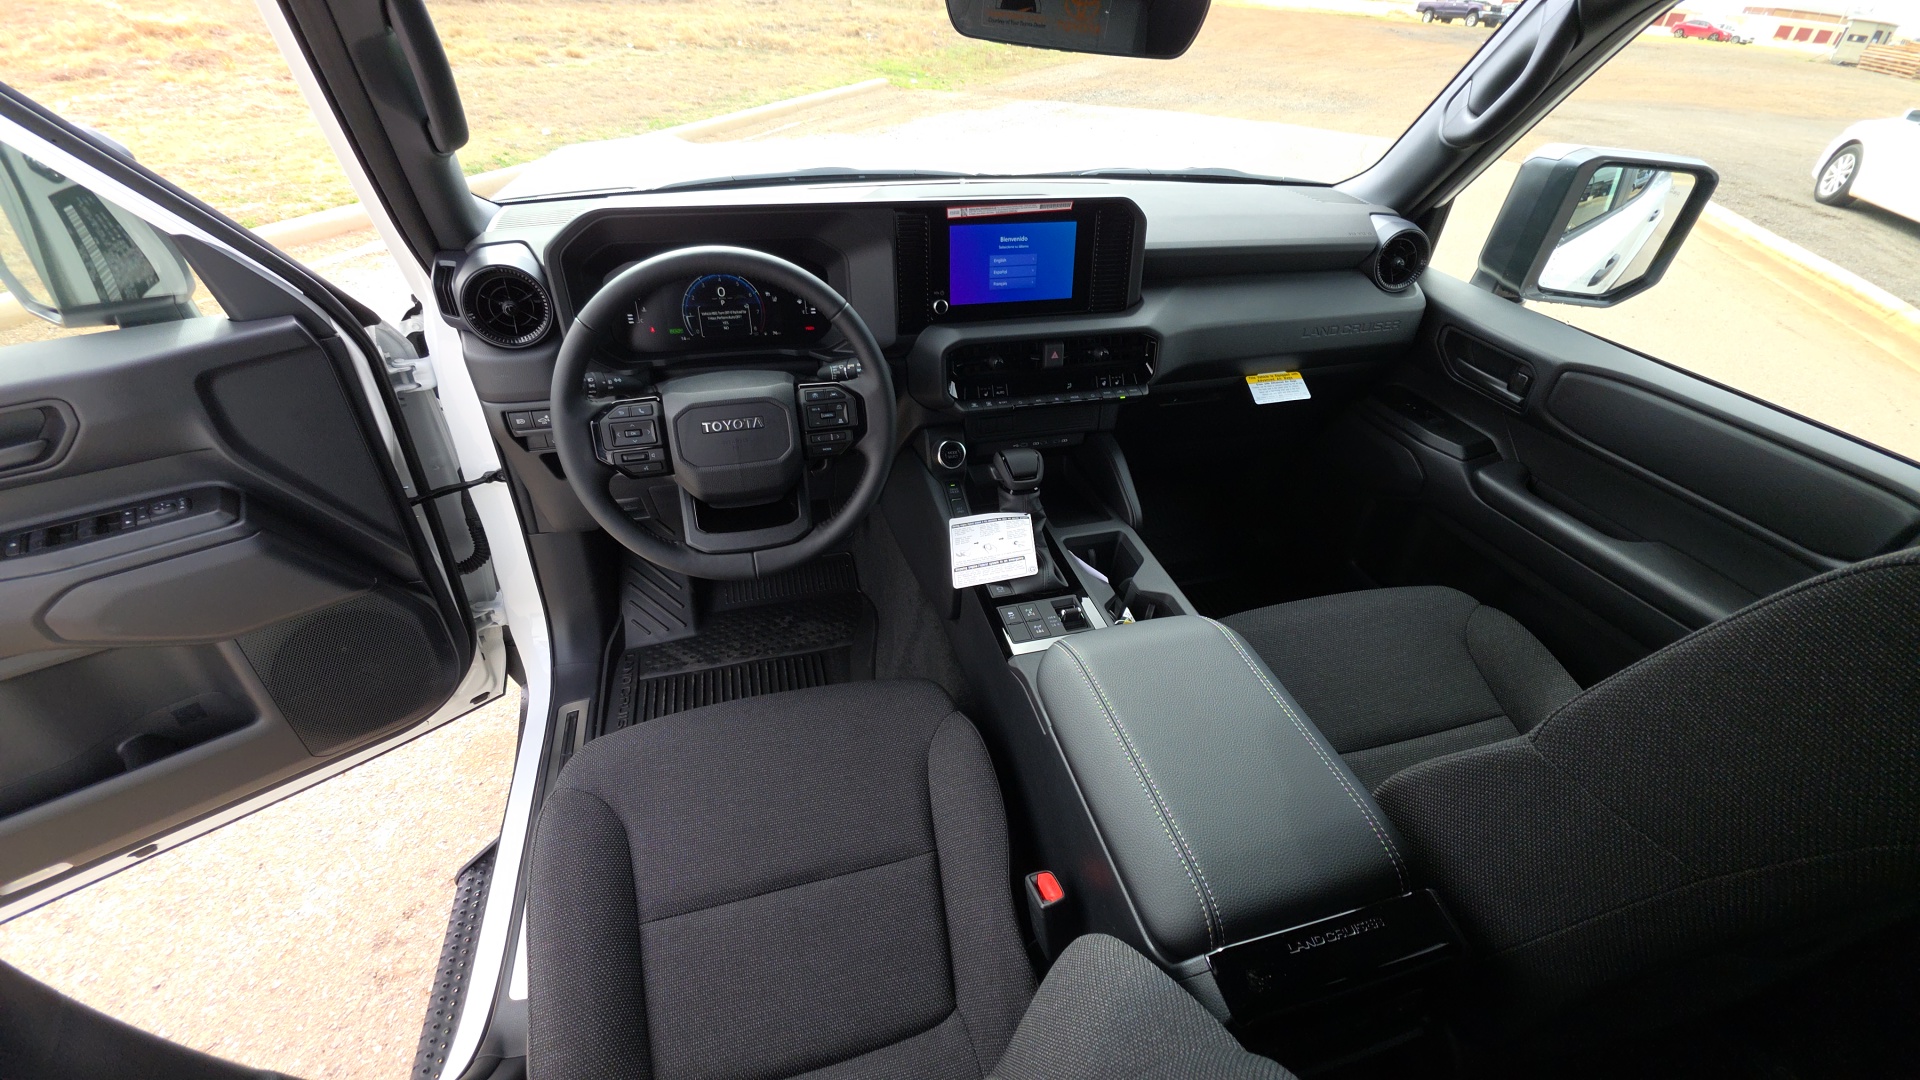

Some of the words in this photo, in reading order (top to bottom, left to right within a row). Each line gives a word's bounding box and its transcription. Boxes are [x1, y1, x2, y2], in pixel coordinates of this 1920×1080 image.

[1000, 235, 1028, 243] Bienvenido
[717, 286, 726, 297] 0
[1302, 324, 1339, 338] LAND
[1340, 320, 1402, 335] CRUISER
[702, 417, 764, 432] TOYOTA
[622, 654, 634, 684] LAND
[617, 686, 632, 730] CRUIS
[1288, 936, 1326, 954] LAND
